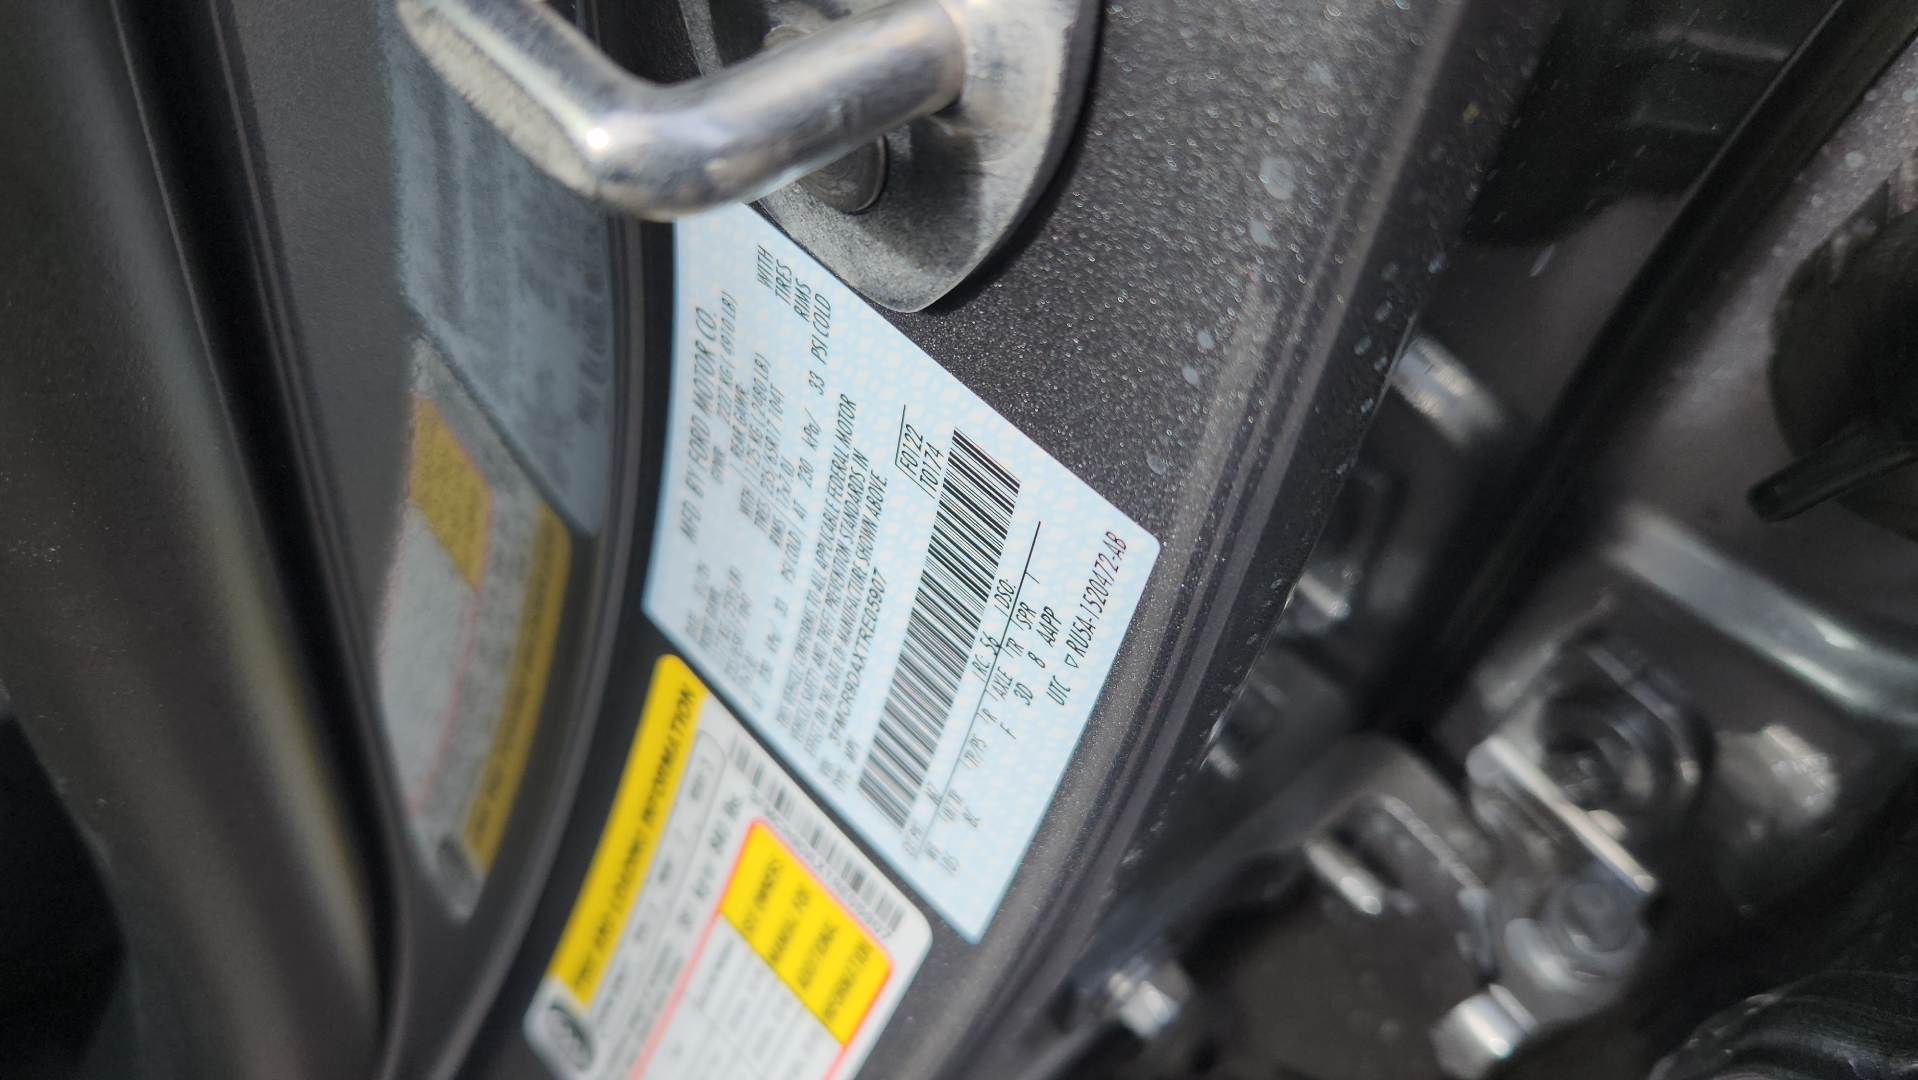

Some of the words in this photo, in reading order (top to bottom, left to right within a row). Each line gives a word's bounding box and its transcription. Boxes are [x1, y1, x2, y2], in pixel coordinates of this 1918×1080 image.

[756, 243, 774, 292] WITH
[774, 256, 792, 308] TIRES
[721, 287, 738, 321] LB)
[793, 275, 811, 323] RIMS
[811, 289, 831, 340] COLD
[695, 296, 717, 346] CO.
[753, 349, 772, 381] LB)
[809, 331, 828, 366] PSI
[692, 337, 716, 420] MOTOR
[719, 362, 733, 391] KG
[808, 367, 824, 397] 33
[716, 385, 732, 426] 2227
[733, 377, 750, 428] GAWR:
[751, 374, 767, 419] 2480
[768, 382, 784, 424] 104T
[748, 419, 763, 449] KG
[801, 407, 822, 453] kPa/
[834, 390, 856, 450] MOTOR
[687, 410, 711, 474] FORD
[730, 422, 745, 461] REAR
[759, 417, 782, 497] 235/65R17
[851, 446, 869, 472] IN
[898, 421, 924, 477] F0122
[684, 462, 706, 500] BY
[744, 441, 760, 483] 1125
[797, 454, 813, 489] 230
[826, 441, 849, 505] FEDERAL
[918, 439, 944, 495] T0174
[739, 482, 755, 521] WITH
[775, 453, 795, 511] 17x7.0J
[864, 464, 887, 521] ABOVE.
[753, 495, 771, 535] TIRES
[791, 497, 806, 521] AT
[838, 464, 865, 546] STANDARDS
[768, 511, 785, 550] RIMS
[783, 526, 801, 566] COLD
[814, 495, 840, 573] APPLICABLE
[855, 512, 878, 568] SHOWN
[780, 558, 795, 586] PSI
[809, 564, 826, 594] ALL
[824, 538, 852, 614] PREVENTION
[993, 572, 1016, 610] DSO:
[773, 592, 788, 618] 33
[805, 585, 821, 611] TO
[836, 558, 868, 648] MANUFACTURE
[1065, 526, 1127, 659] RU5A-1520472-AB
[816, 606, 836, 648] THEFT
[1015, 598, 1037, 631] SPR
[1035, 603, 1063, 648] AAPP
[791, 602, 818, 669] CONFORMS
[809, 637, 829, 672] AND
[831, 637, 848, 664] OF
[979, 628, 1001, 656] 56
[1005, 634, 1024, 659] TR
[824, 653, 844, 691] DATE
[828, 564, 888, 750] 3FMCR9DAXTRE05907
[972, 649, 990, 677] RC:
[1026, 648, 1046, 670] 8
[781, 658, 803, 709] VEHICLE
[800, 662, 822, 708] SAFETY
[819, 682, 836, 711] THE
[990, 664, 1013, 700] AXLE
[1013, 678, 1034, 707] 3D
[1045, 672, 1071, 708] UTC
[813, 702, 830, 728] ON
[981, 705, 998, 723] R
[999, 721, 1017, 741] F
[639, 681, 696, 830] INFORMATION
[842, 733, 861, 765] MPV
[963, 730, 987, 770] TP/PS
[940, 797, 959, 823] INT
[947, 785, 965, 808] TR
[961, 804, 981, 829] 8C
